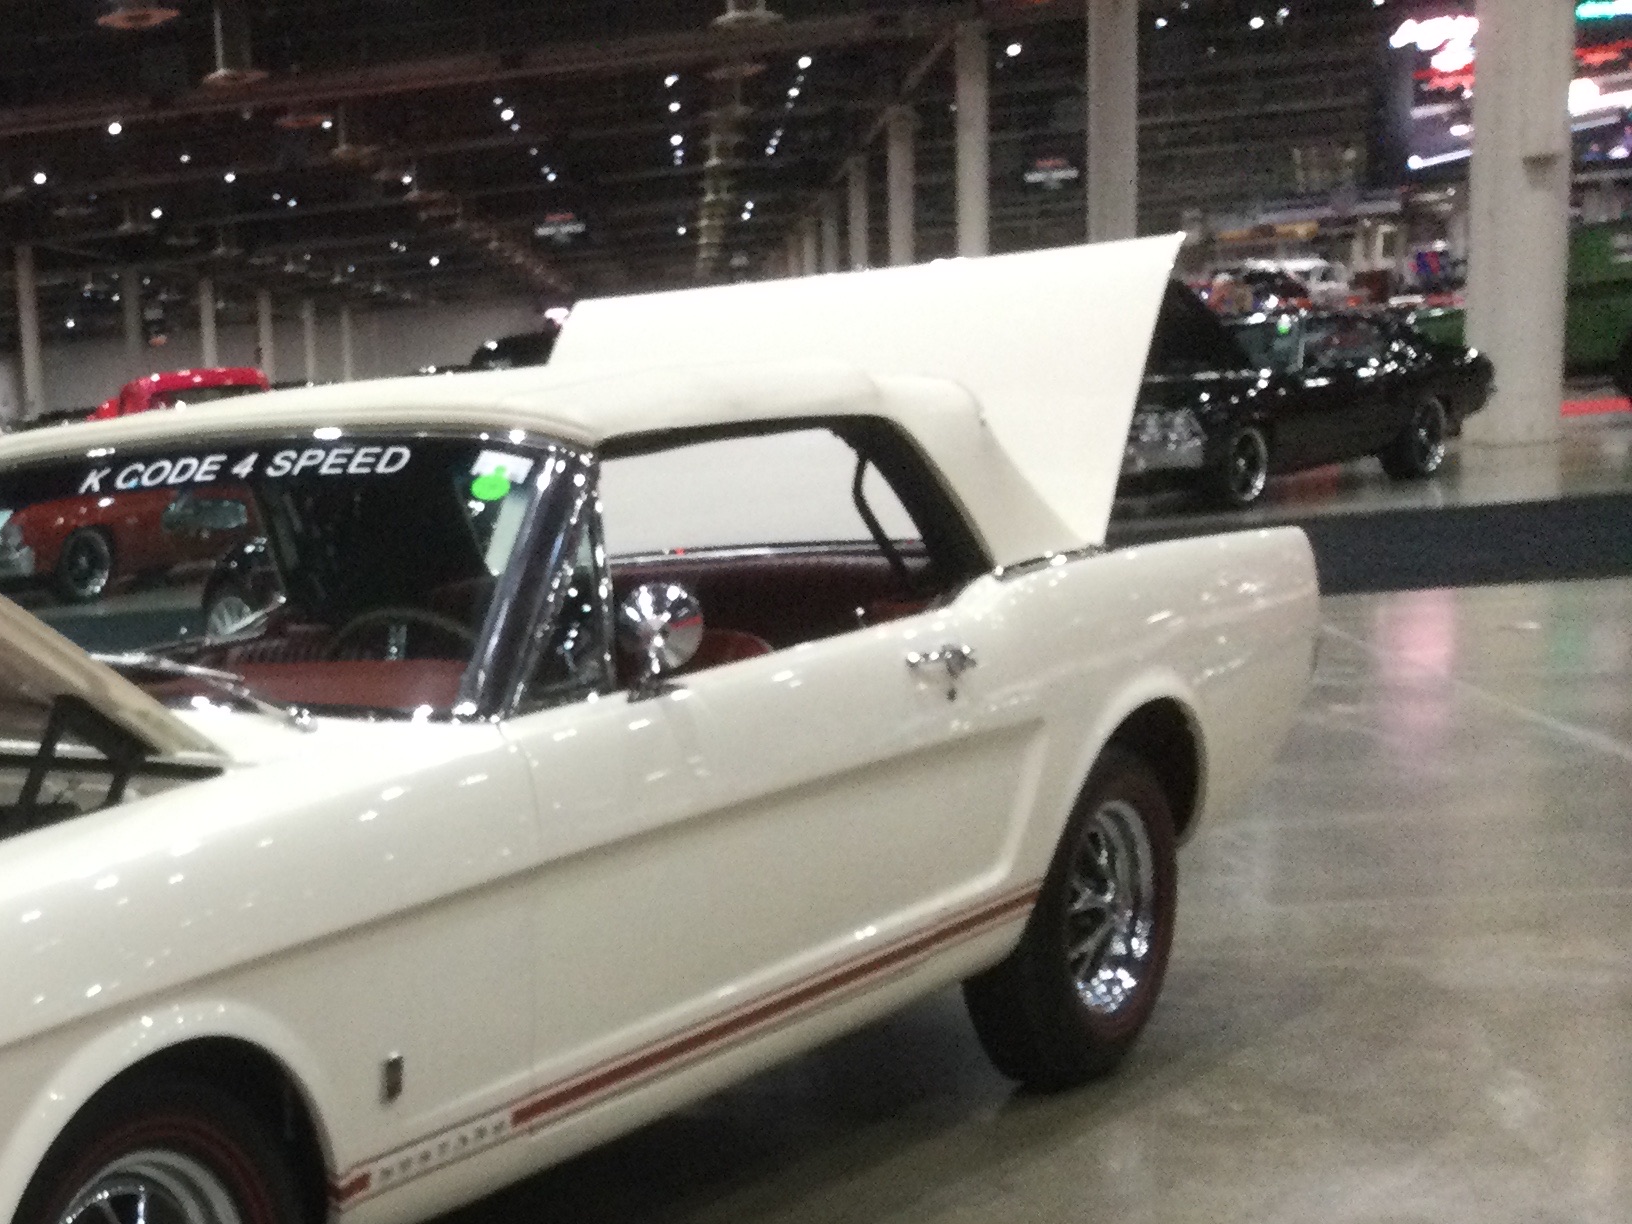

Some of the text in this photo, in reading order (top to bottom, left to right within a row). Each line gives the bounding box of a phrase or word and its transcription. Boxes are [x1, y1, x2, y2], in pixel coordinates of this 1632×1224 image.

[79, 445, 411, 494] K CODE 4 SPEED
